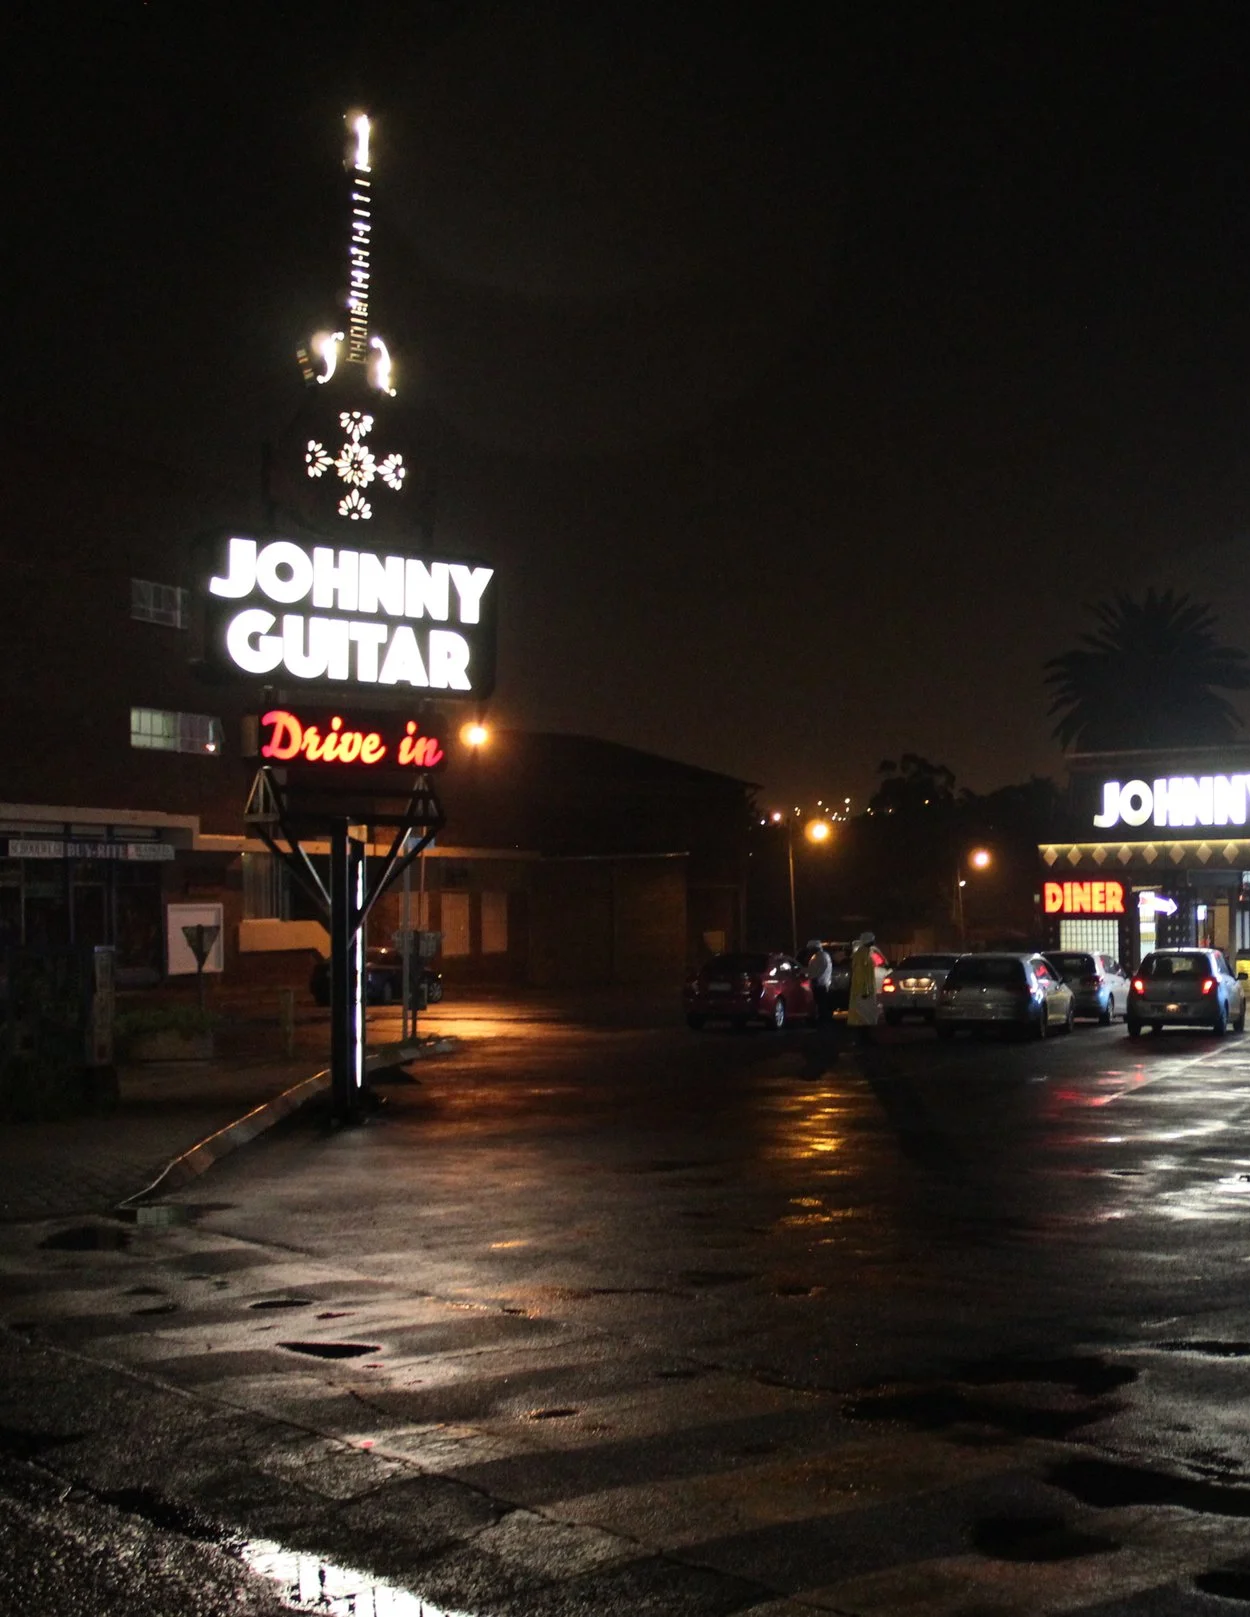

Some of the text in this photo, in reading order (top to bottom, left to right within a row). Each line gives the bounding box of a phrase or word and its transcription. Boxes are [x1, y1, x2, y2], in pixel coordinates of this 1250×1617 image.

[208, 537, 495, 625] JOHNNY
[226, 608, 472, 691] GUITAR
[261, 710, 443, 767] Drive in
[1043, 880, 1127, 914] DINER
